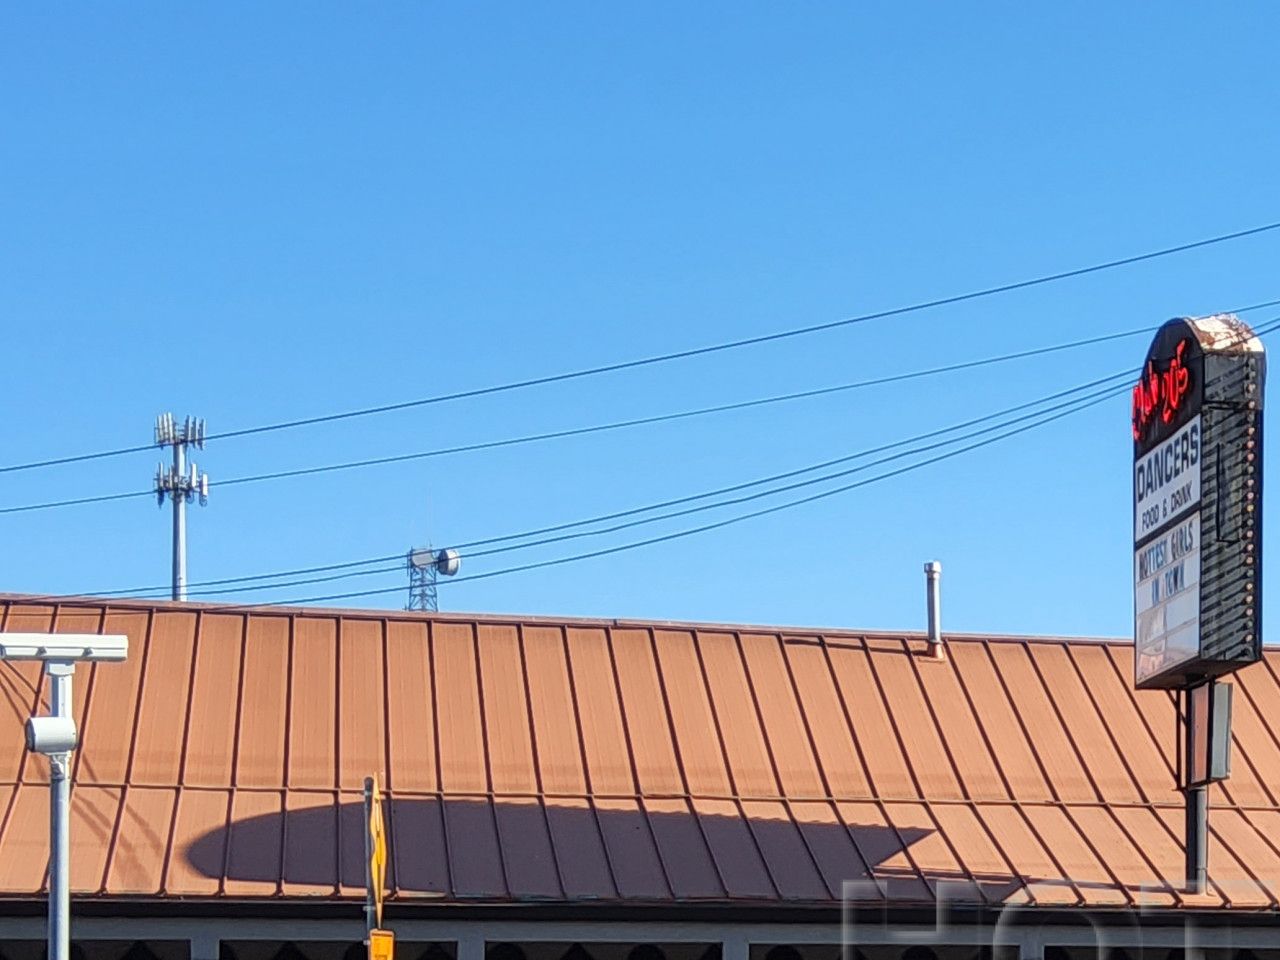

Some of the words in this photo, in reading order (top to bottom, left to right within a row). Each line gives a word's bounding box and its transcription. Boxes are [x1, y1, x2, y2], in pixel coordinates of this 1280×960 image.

[1136, 423, 1199, 503] DANCERS
[1142, 503, 1160, 532] FOOD
[1163, 498, 1168, 519] &
[1170, 480, 1193, 513] DRINK
[1138, 539, 1168, 582] HOTTEST
[1171, 521, 1194, 561] GIRLS
[1151, 576, 1160, 607] IN
[1165, 560, 1185, 598] TOWN
